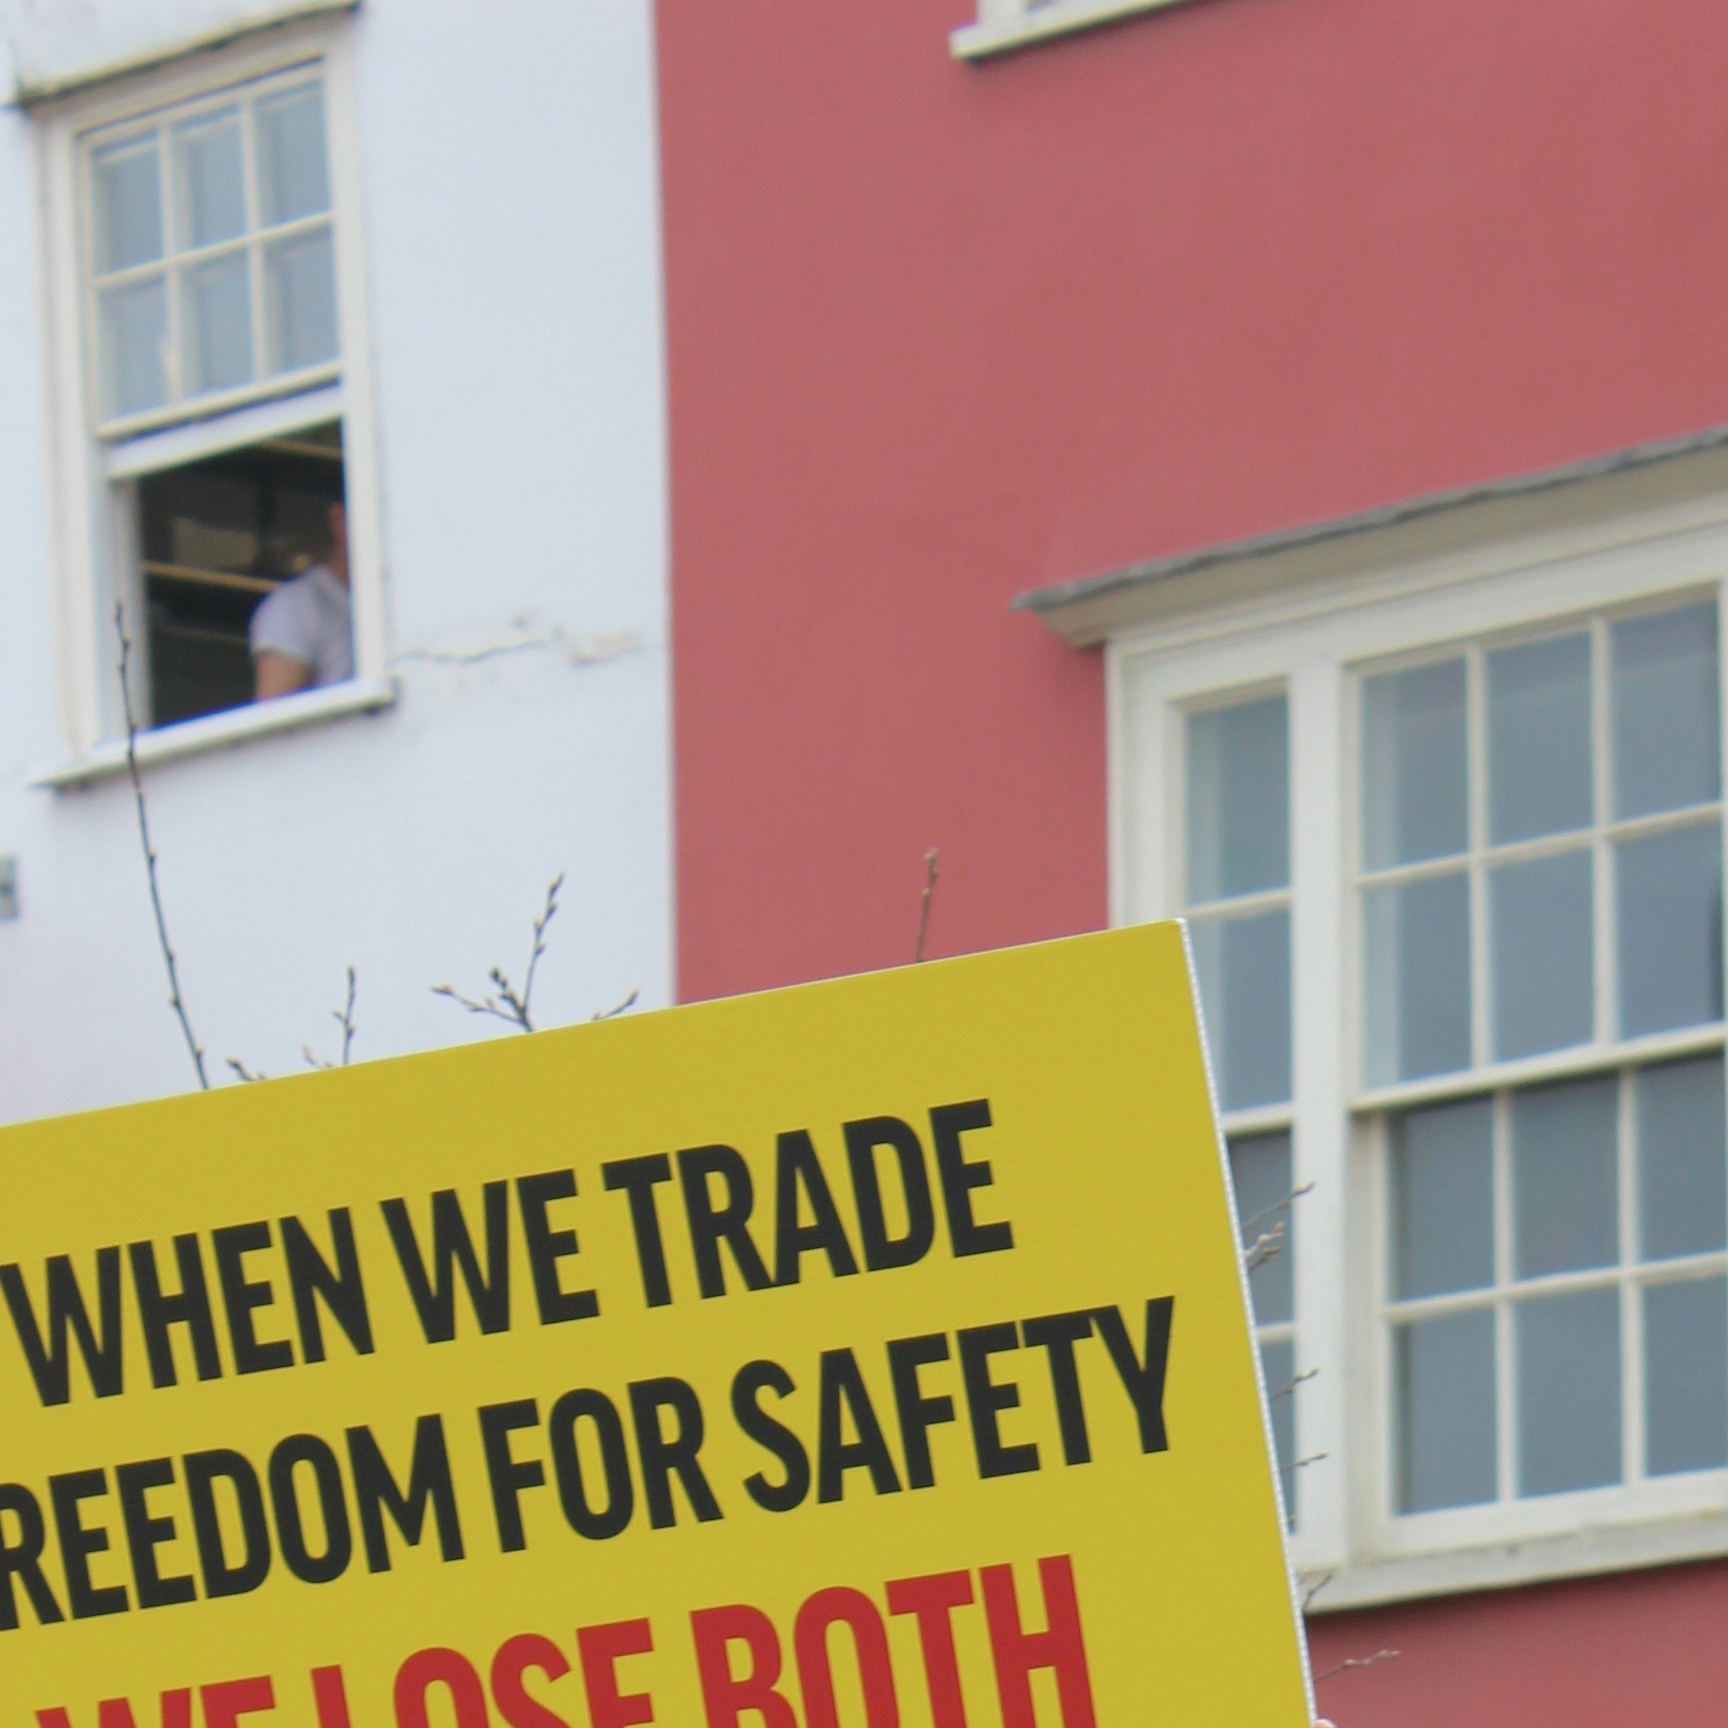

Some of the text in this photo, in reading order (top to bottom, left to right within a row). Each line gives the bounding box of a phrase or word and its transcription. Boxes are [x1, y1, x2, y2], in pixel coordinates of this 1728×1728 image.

[0, 1098, 1015, 1408] WHEN WE TRADE
[0, 1295, 1174, 1632] REEDOM FOR SAFETY
